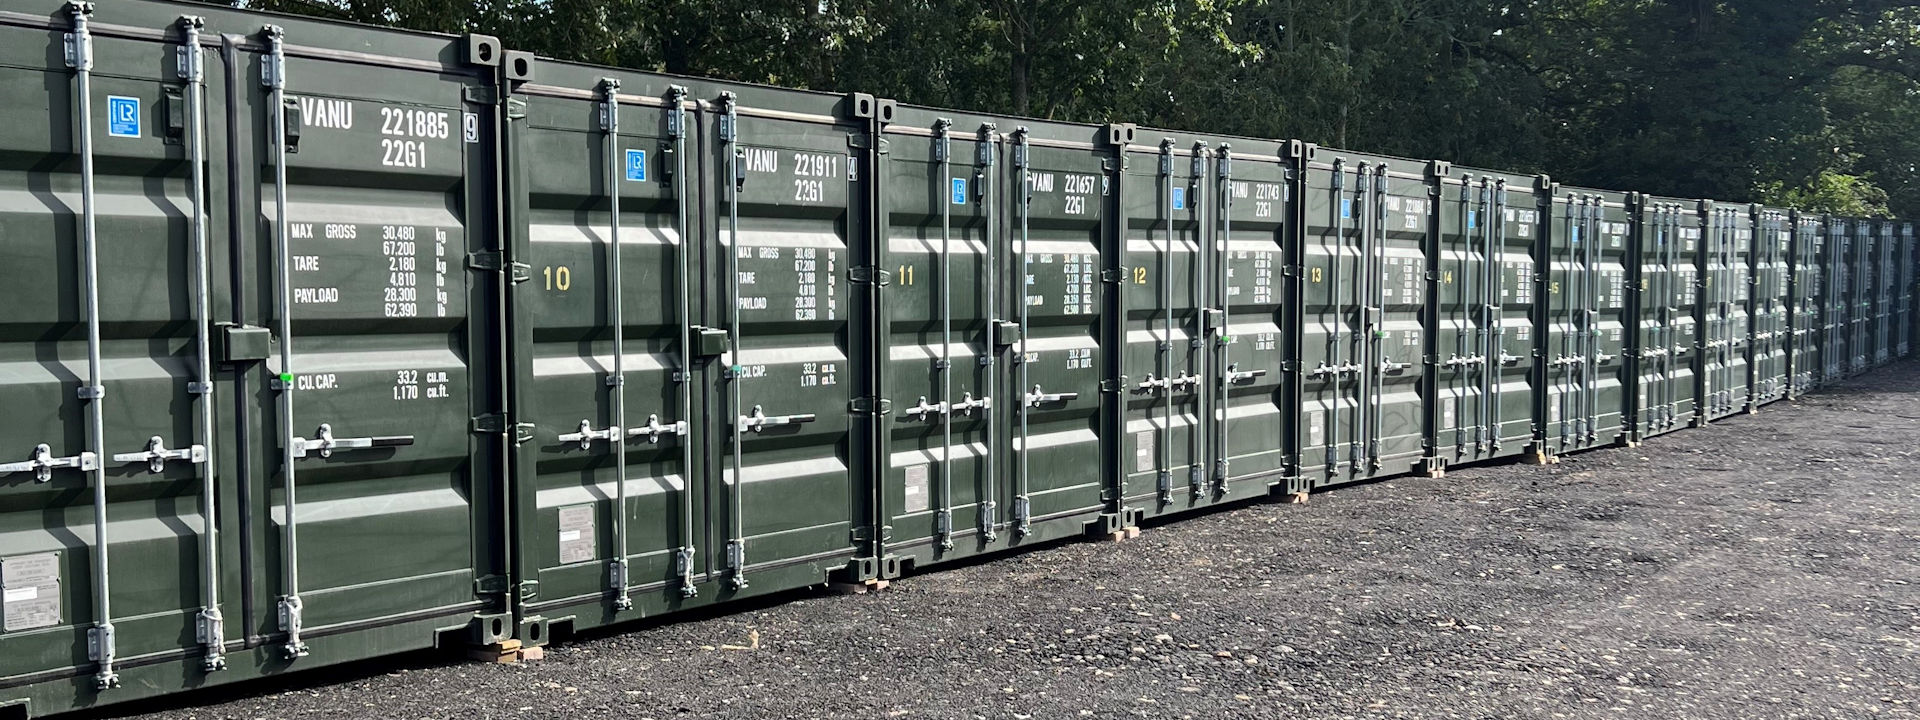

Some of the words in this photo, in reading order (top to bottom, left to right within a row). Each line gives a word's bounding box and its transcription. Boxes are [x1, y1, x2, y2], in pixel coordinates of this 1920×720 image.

[120, 103, 135, 122] LR
[301, 97, 352, 130] VANU
[380, 107, 449, 140] 221885
[466, 115, 476, 140] 9
[381, 139, 426, 169] 22G1
[745, 148, 778, 173] VANU
[794, 153, 837, 178] 221911
[849, 158, 856, 180] 4
[794, 179, 823, 202] 22G1
[1032, 172, 1054, 192] VANU
[1064, 174, 1096, 194] 221657
[1103, 177, 1109, 194] 9
[1231, 181, 1249, 198] VANU
[1256, 183, 1280, 200] 221743
[1064, 195, 1085, 215] 22G1
[291, 223, 313, 239] MAX
[325, 223, 357, 239] GROSS
[436, 227, 446, 244] kg
[436, 242, 445, 257] lb
[738, 246, 752, 259] MAX
[759, 246, 780, 259] GROSS
[828, 248, 836, 262] kg
[292, 255, 320, 271] TARE
[436, 257, 447, 274] kg
[436, 272, 445, 287] lb
[543, 265, 571, 291] 10
[738, 271, 756, 284] TARE
[828, 272, 836, 286] kg
[899, 264, 913, 286] 11
[1133, 266, 1146, 284] 12
[1311, 267, 1322, 283] 13
[1444, 270, 1453, 284] 14
[294, 287, 339, 304] PAYLOAD
[437, 287, 448, 305] kg
[738, 296, 767, 310] PAYLOAD
[828, 297, 836, 310] kg
[437, 303, 446, 318] lb
[397, 369, 418, 385] 33.2
[426, 371, 449, 383] cu.m.
[803, 362, 817, 375] 33.2
[426, 385, 449, 398] cu.ft.
